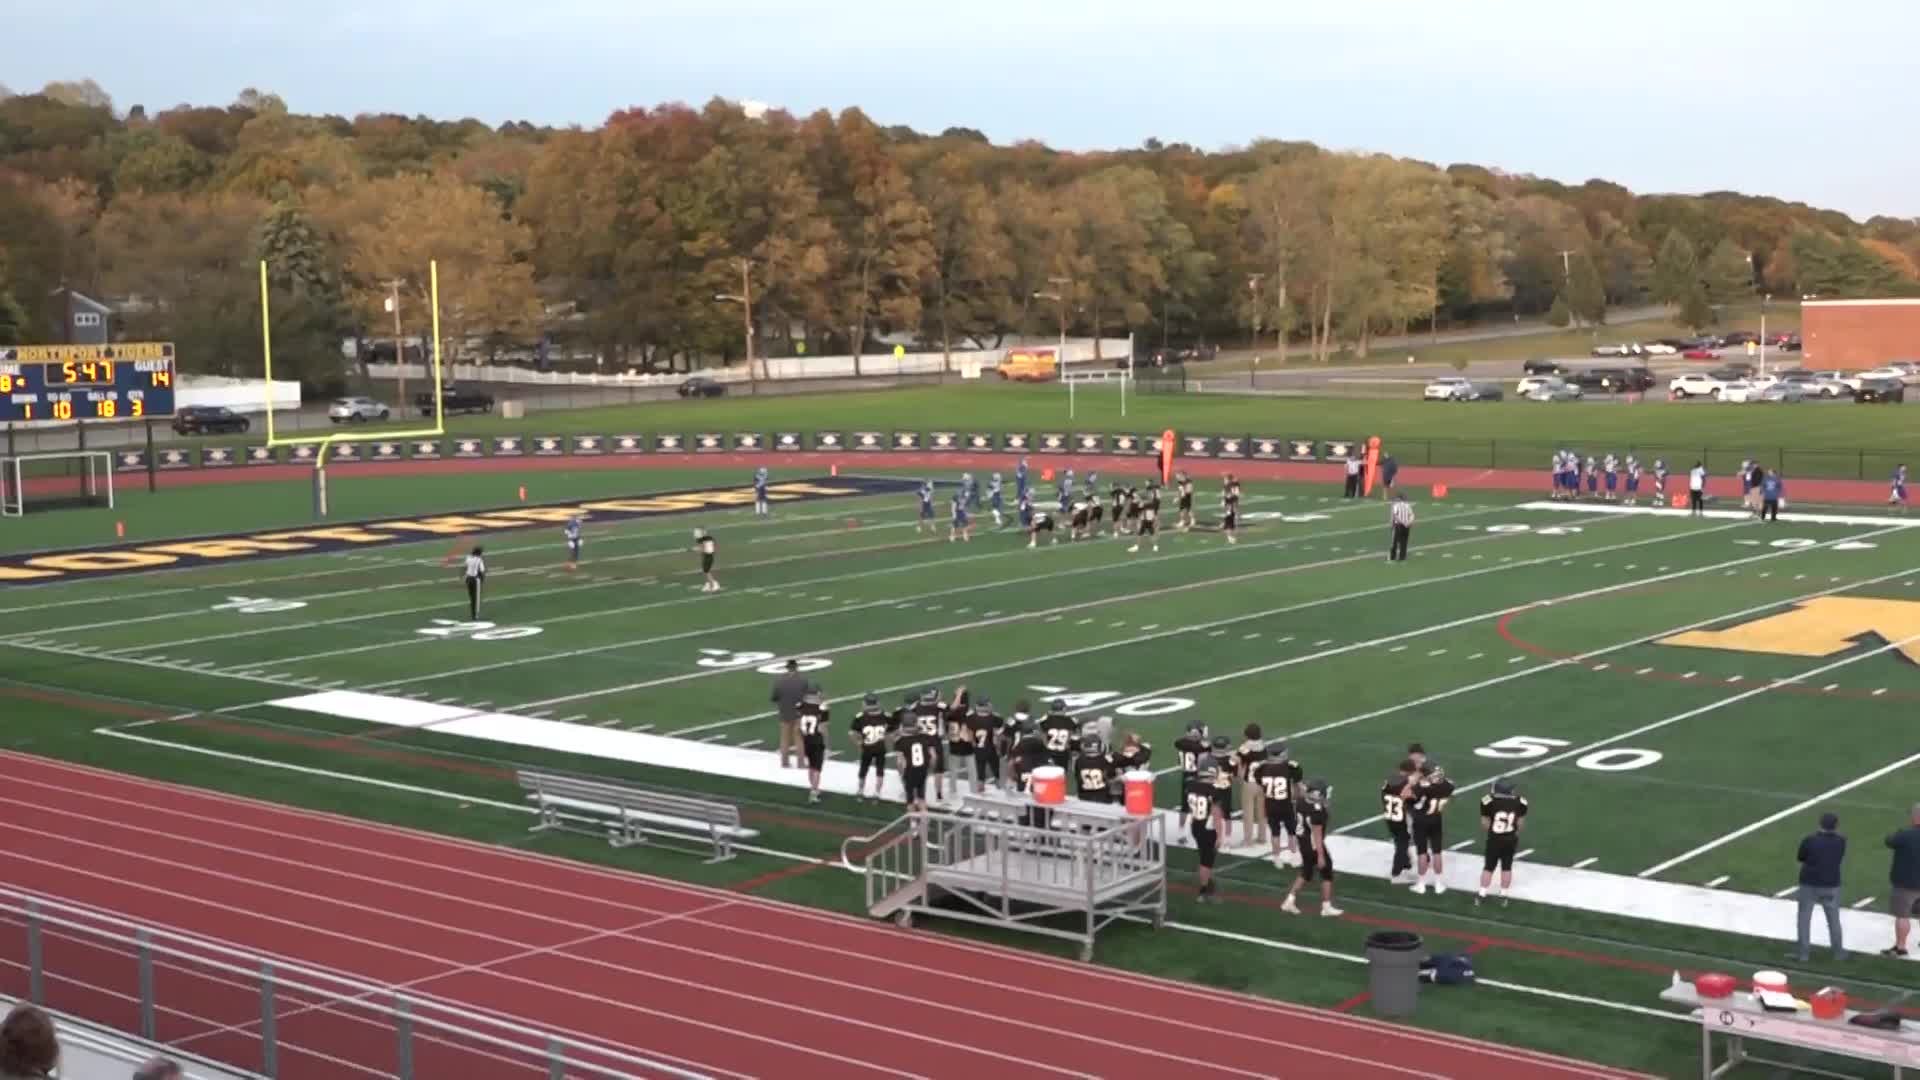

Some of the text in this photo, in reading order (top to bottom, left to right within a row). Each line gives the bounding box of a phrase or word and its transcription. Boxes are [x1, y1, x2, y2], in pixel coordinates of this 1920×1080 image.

[64, 360, 111, 382] 5:47
[152, 372, 168, 386] 14
[54, 402, 71, 419] 10
[98, 400, 115, 417] 18
[132, 400, 142, 416] 3
[1047, 729, 1069, 751] 29
[911, 743, 924, 767] 8
[1474, 736, 1663, 771] 50
[1262, 776, 1287, 800] 72
[1383, 795, 1403, 821] 33
[1492, 812, 1516, 833] 61
